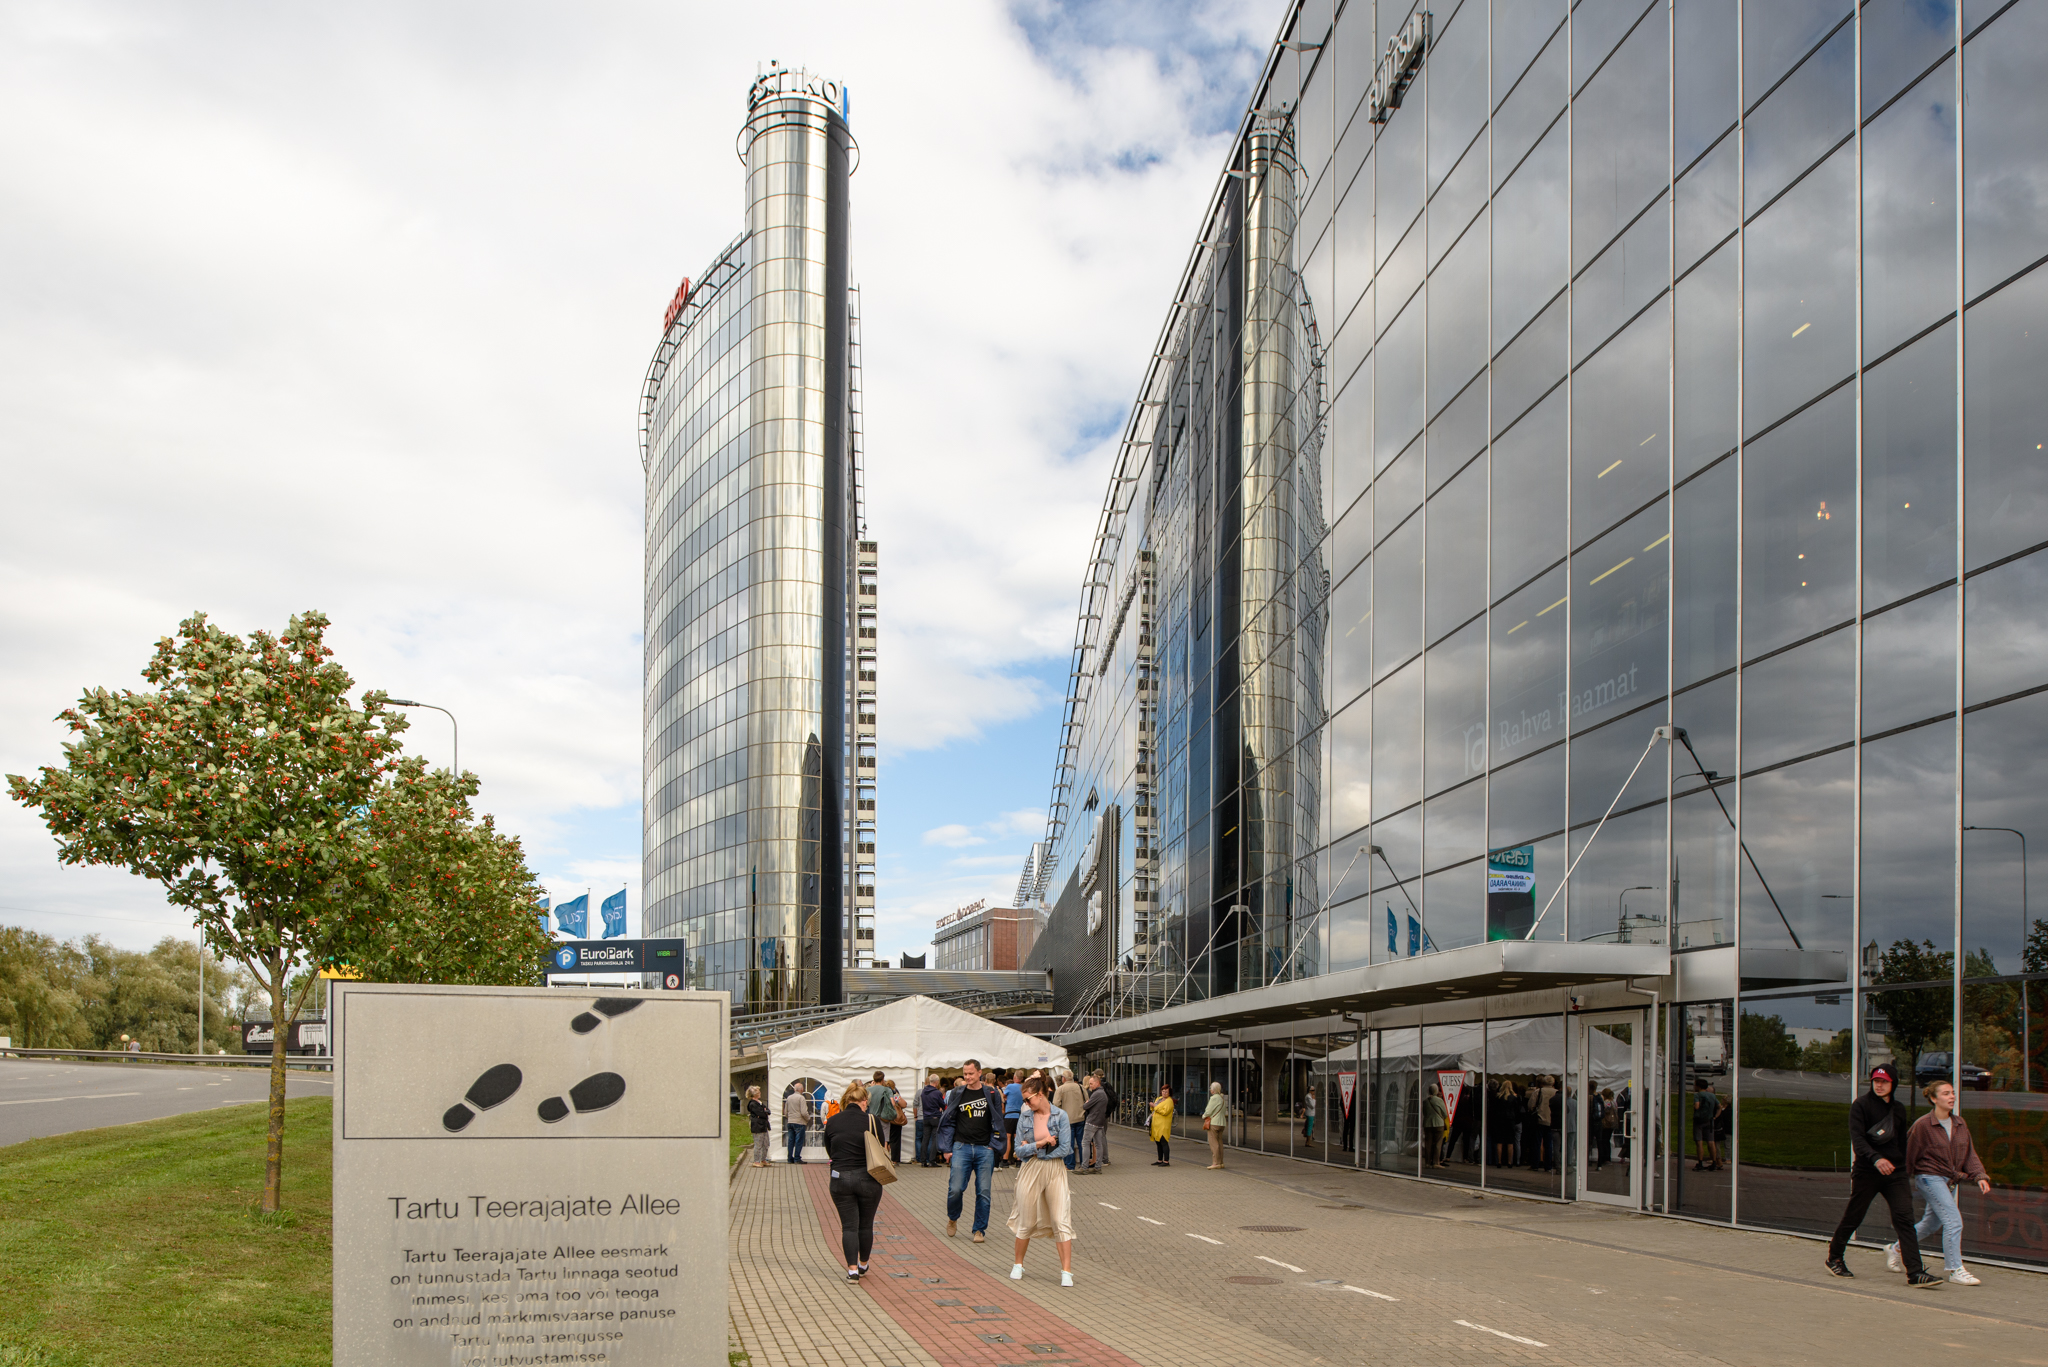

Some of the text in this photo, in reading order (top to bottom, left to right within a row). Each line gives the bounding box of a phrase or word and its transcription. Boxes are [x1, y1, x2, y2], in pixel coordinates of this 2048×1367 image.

[1499, 709, 1552, 751] Rahva
[580, 946, 634, 960] EuroPark
[1341, 1075, 1355, 1085] GUESS
[1441, 1075, 1461, 1087] GUESS
[973, 1109, 986, 1117] DAY
[387, 1193, 681, 1222] Tartu Teerajajate Allee
[403, 1243, 668, 1264] Tartu Teerajajate Allee eesmärk
[390, 1264, 678, 1285] on tunnustada Tartu linnaga seotud
[482, 1290, 509, 1303] kes
[515, 1292, 549, 1303] oma
[586, 1287, 609, 1300] või
[615, 1287, 660, 1302] teoga
[392, 1308, 676, 1329] on andnud märkimisväärse panuse
[450, 1331, 624, 1347] Tartu linna arengusse
